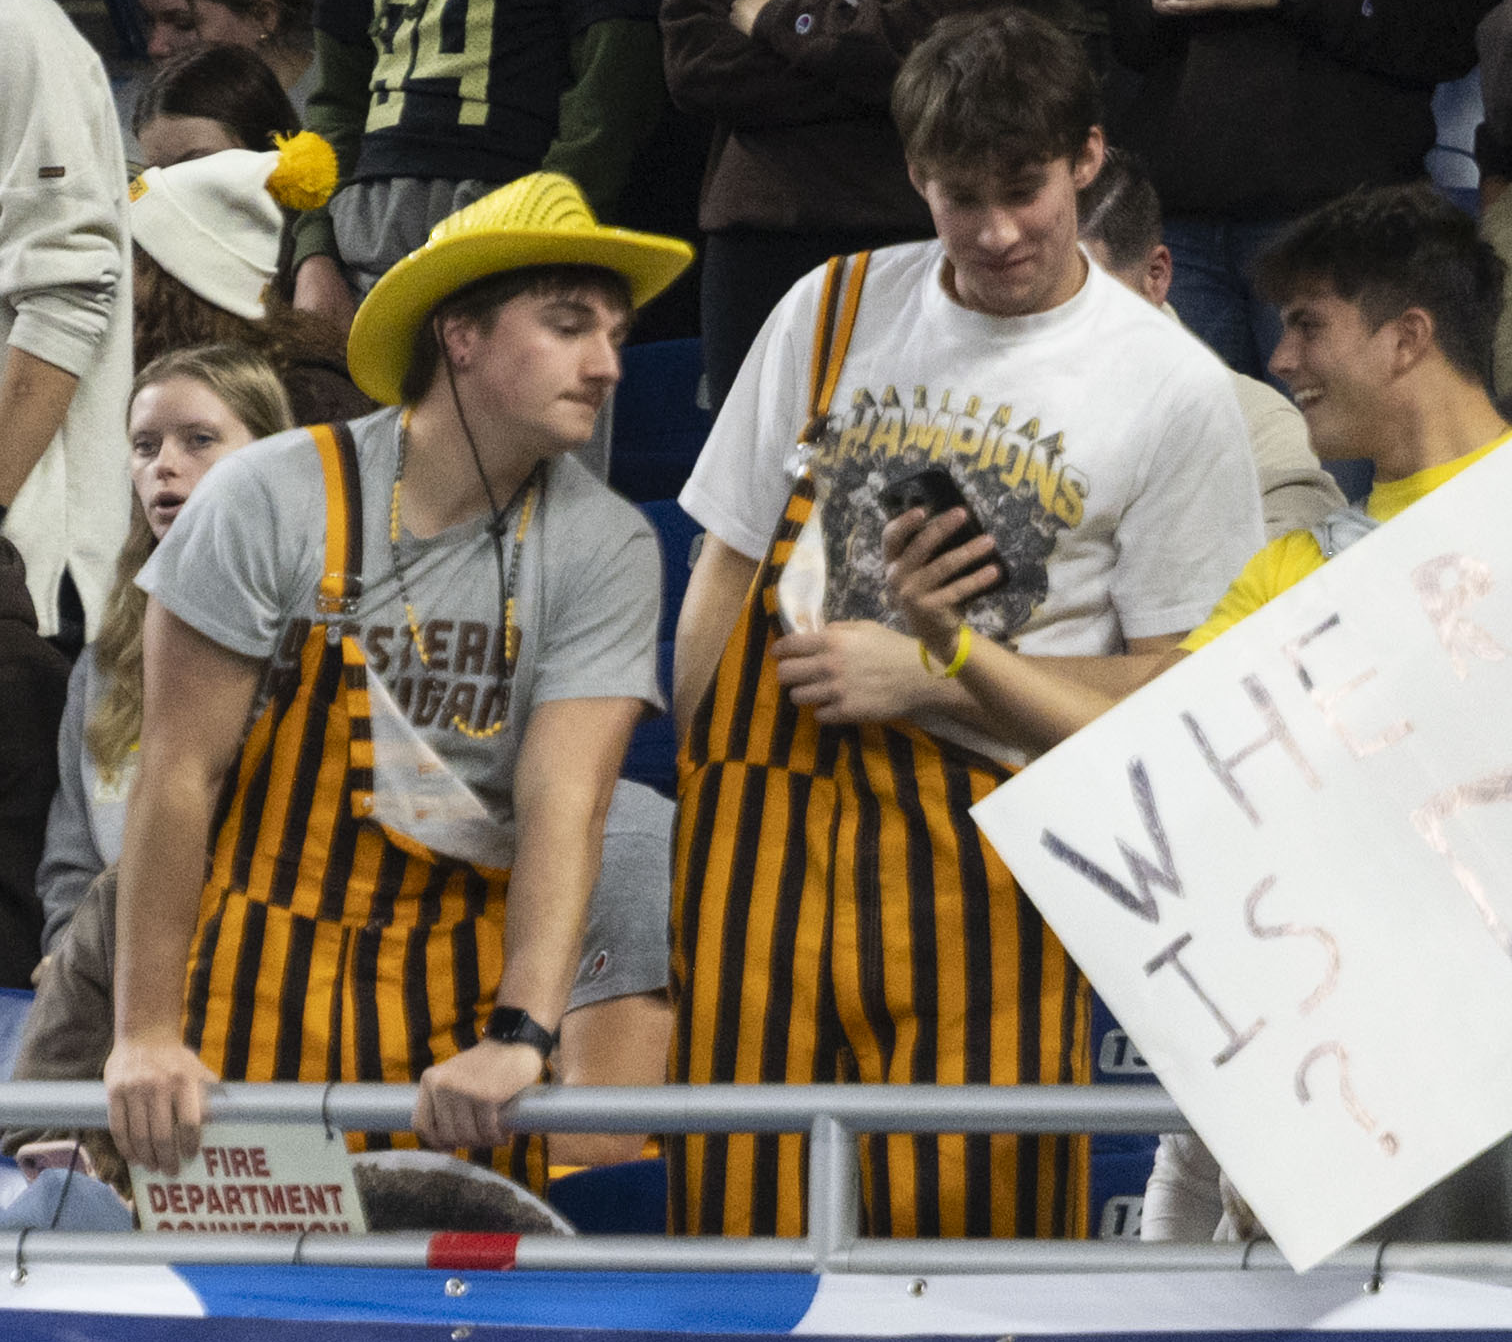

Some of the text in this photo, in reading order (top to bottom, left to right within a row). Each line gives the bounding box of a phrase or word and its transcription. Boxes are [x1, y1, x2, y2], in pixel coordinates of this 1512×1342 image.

[1142, 875, 1340, 1069] IS
[1295, 1042, 1400, 1159] ?
[147, 1184, 344, 1216] DEPARTMENT
[205, 1147, 272, 1179] FIRE
